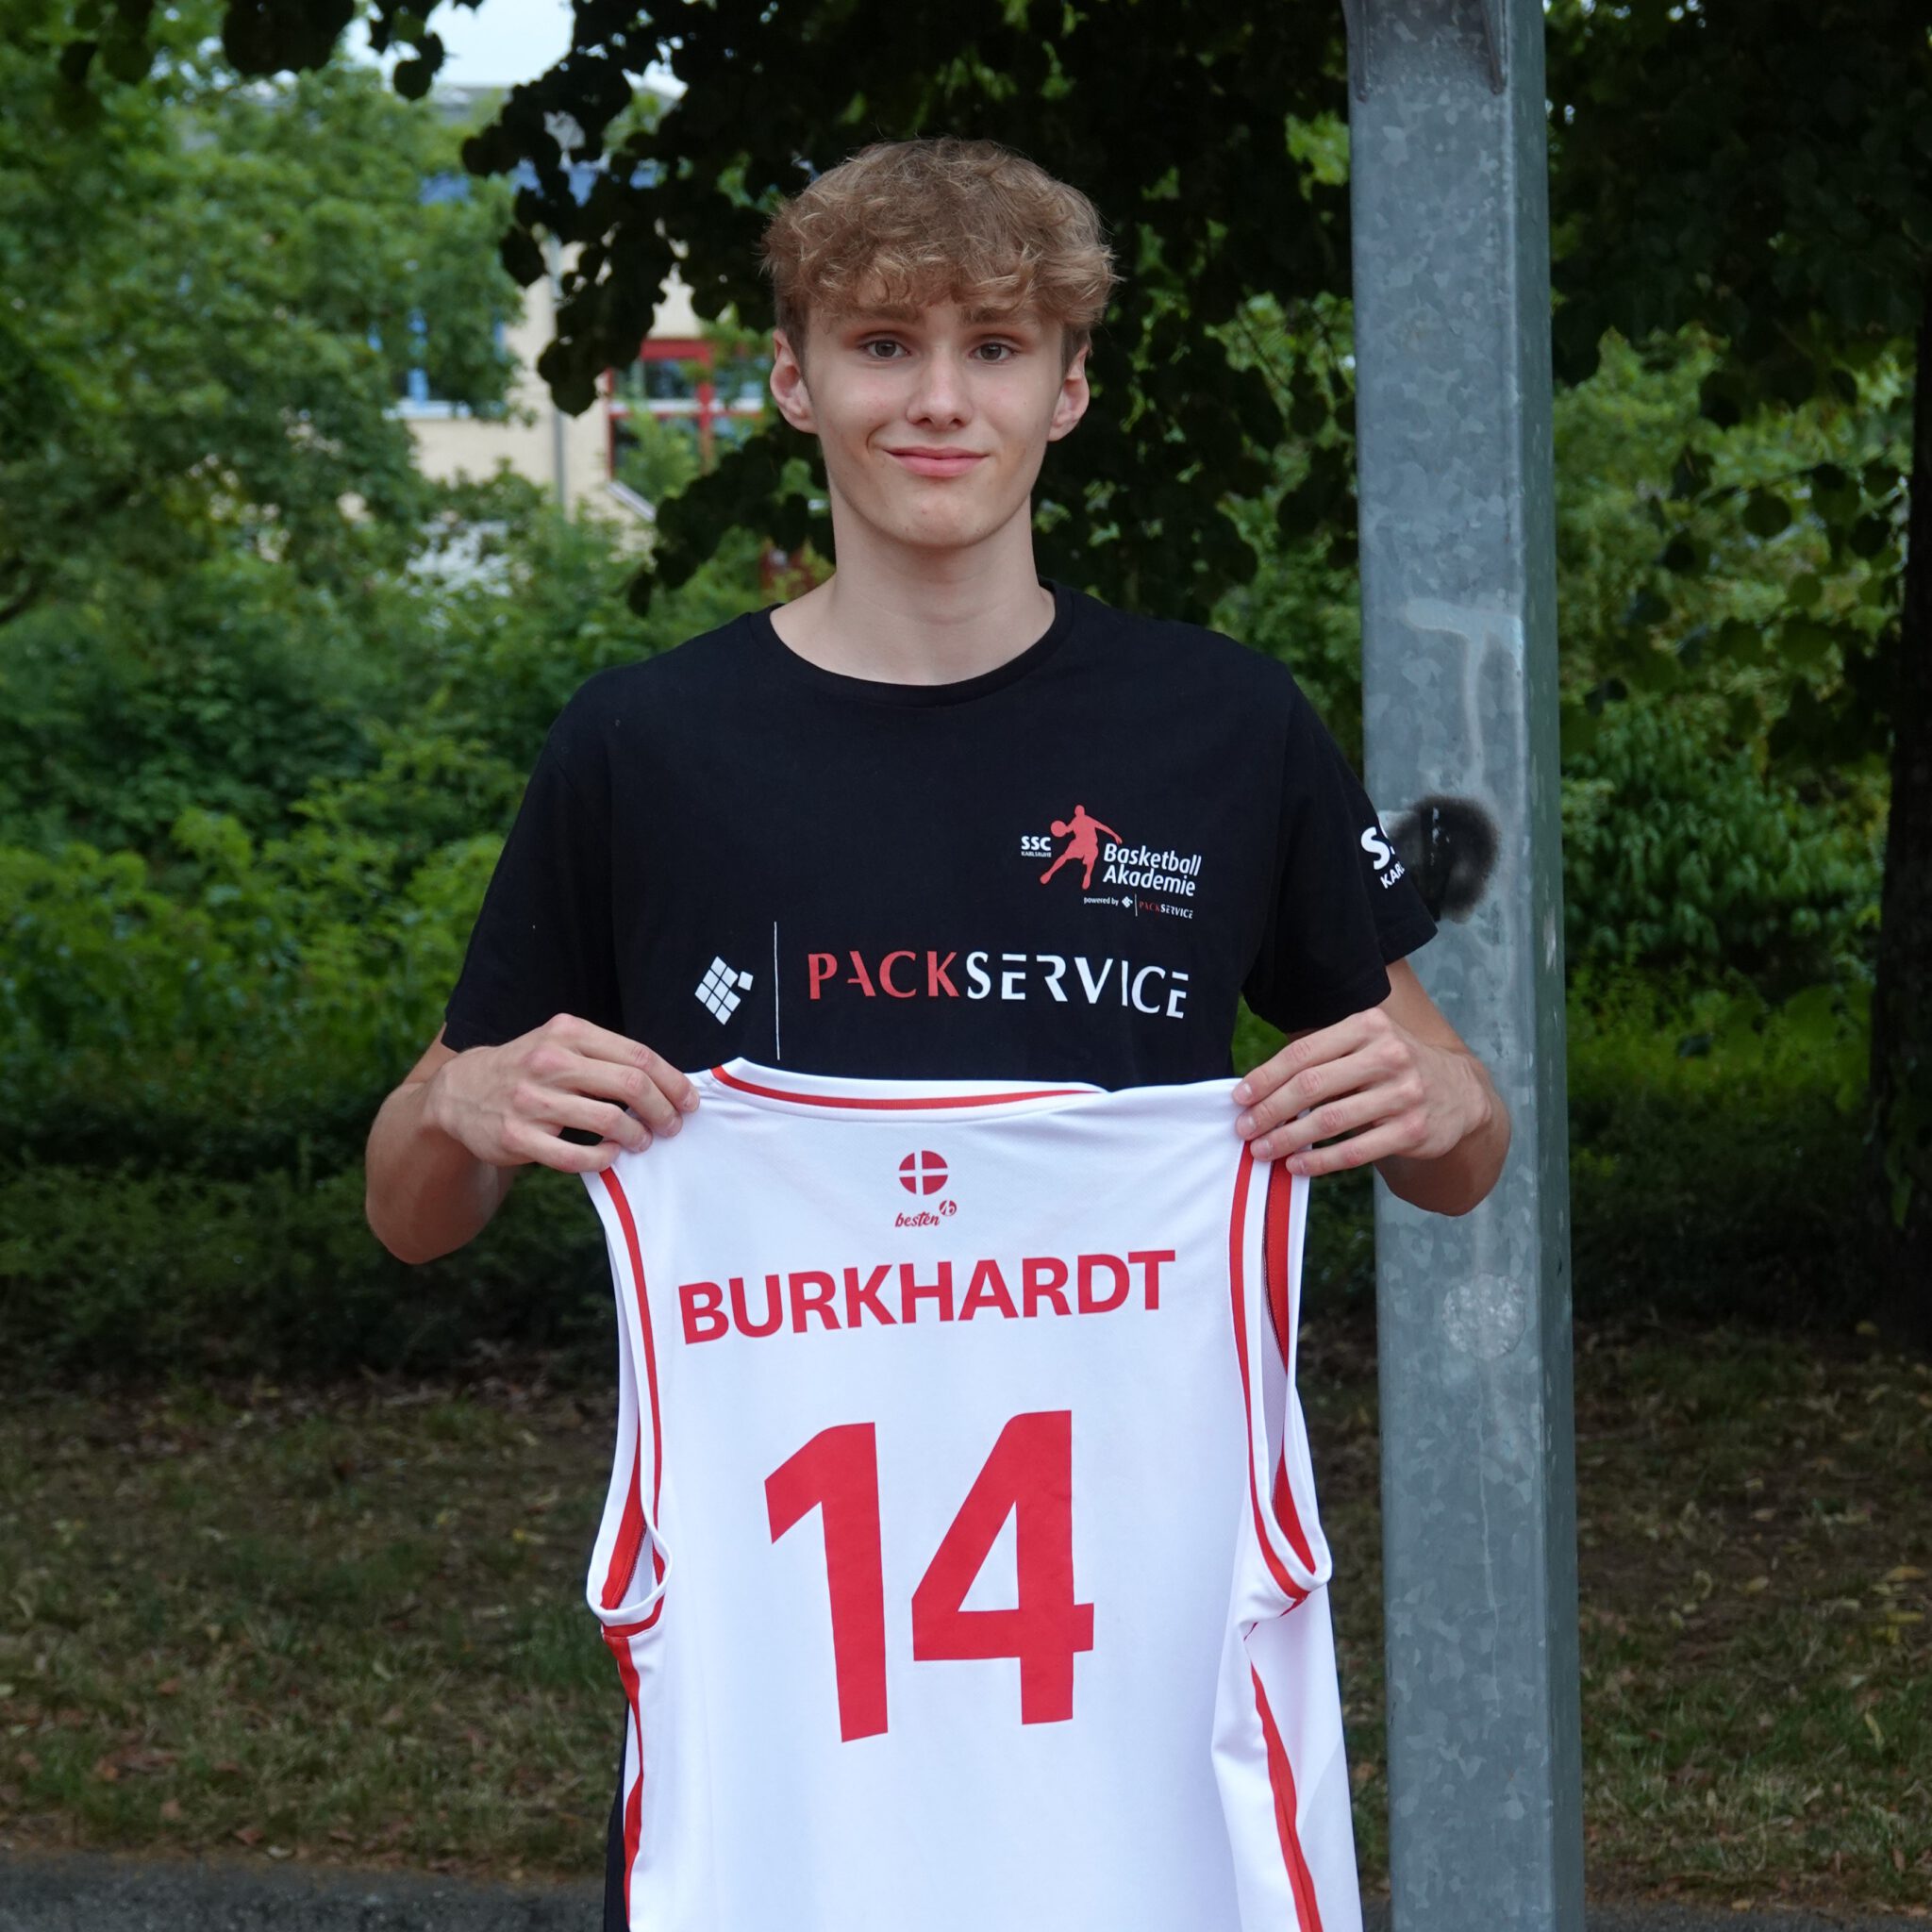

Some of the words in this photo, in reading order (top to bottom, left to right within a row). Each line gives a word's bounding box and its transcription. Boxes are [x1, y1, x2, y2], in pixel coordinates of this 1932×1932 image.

[1021, 836, 1052, 851] SSC
[1103, 842, 1202, 876] Basketball
[1360, 822, 1396, 870] S
[1102, 864, 1196, 896] Akademie
[1083, 896, 1110, 905] powered
[1111, 897, 1119, 907] by
[1139, 901, 1193, 919] PACKSERVICE
[807, 950, 1190, 1020] PACKSERVICE
[678, 1249, 1175, 1344] BURKHARDT
[764, 1409, 1094, 1743] 14
